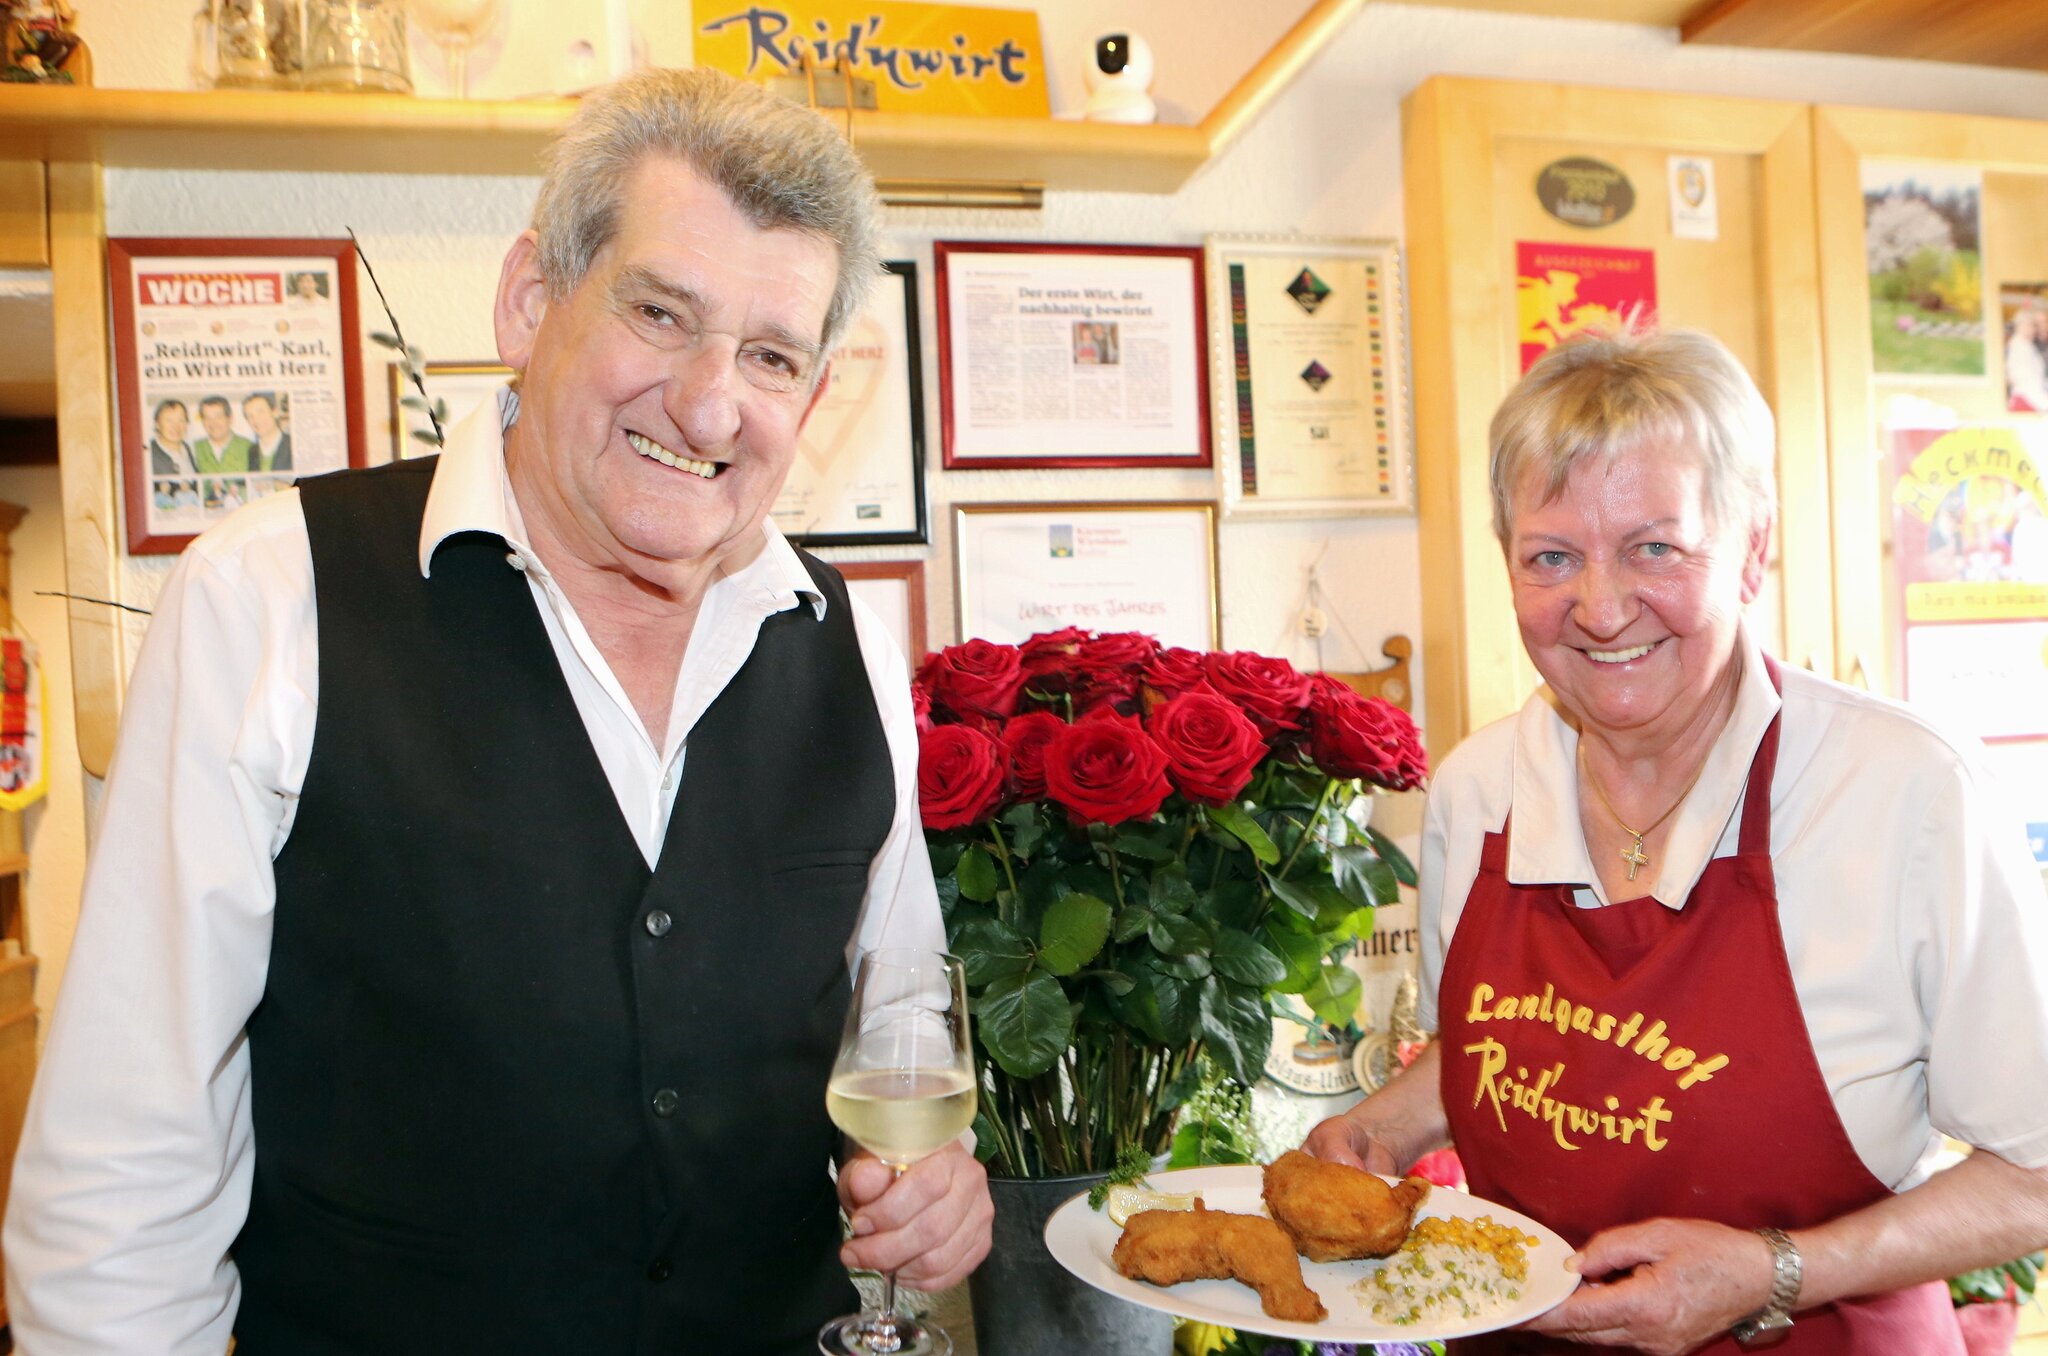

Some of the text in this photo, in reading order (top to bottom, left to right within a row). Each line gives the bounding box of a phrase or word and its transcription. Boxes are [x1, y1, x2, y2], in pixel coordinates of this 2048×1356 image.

[146, 278, 276, 305] WOCHE
[144, 359, 327, 379] ein Wirt mit Herz
[1466, 982, 1730, 1090] Landgasthof
